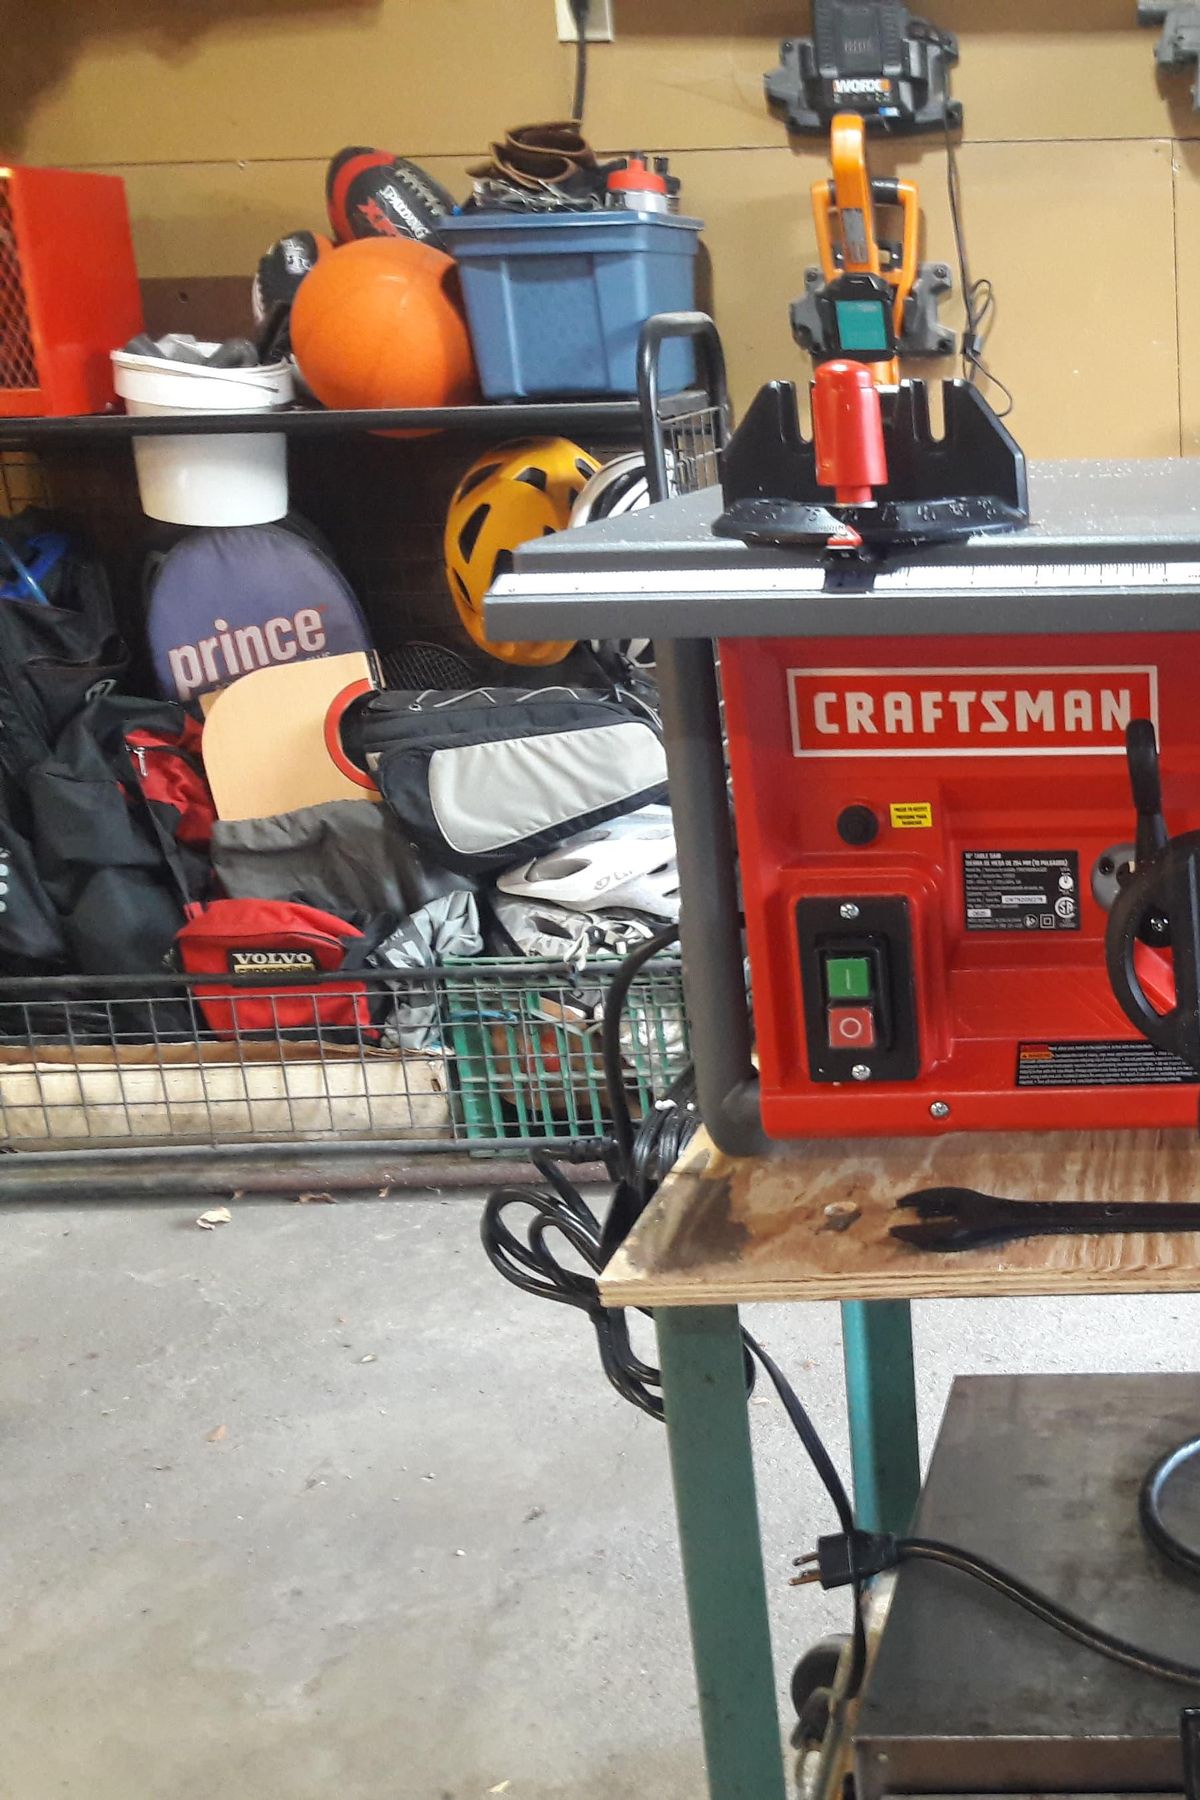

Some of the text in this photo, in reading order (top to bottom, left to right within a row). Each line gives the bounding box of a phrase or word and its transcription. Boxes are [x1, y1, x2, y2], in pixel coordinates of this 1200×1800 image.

[833, 79, 884, 93] WORX
[168, 607, 326, 700] prince
[812, 688, 1132, 735] CRAFTSMAN
[231, 952, 313, 965] VOLVO
